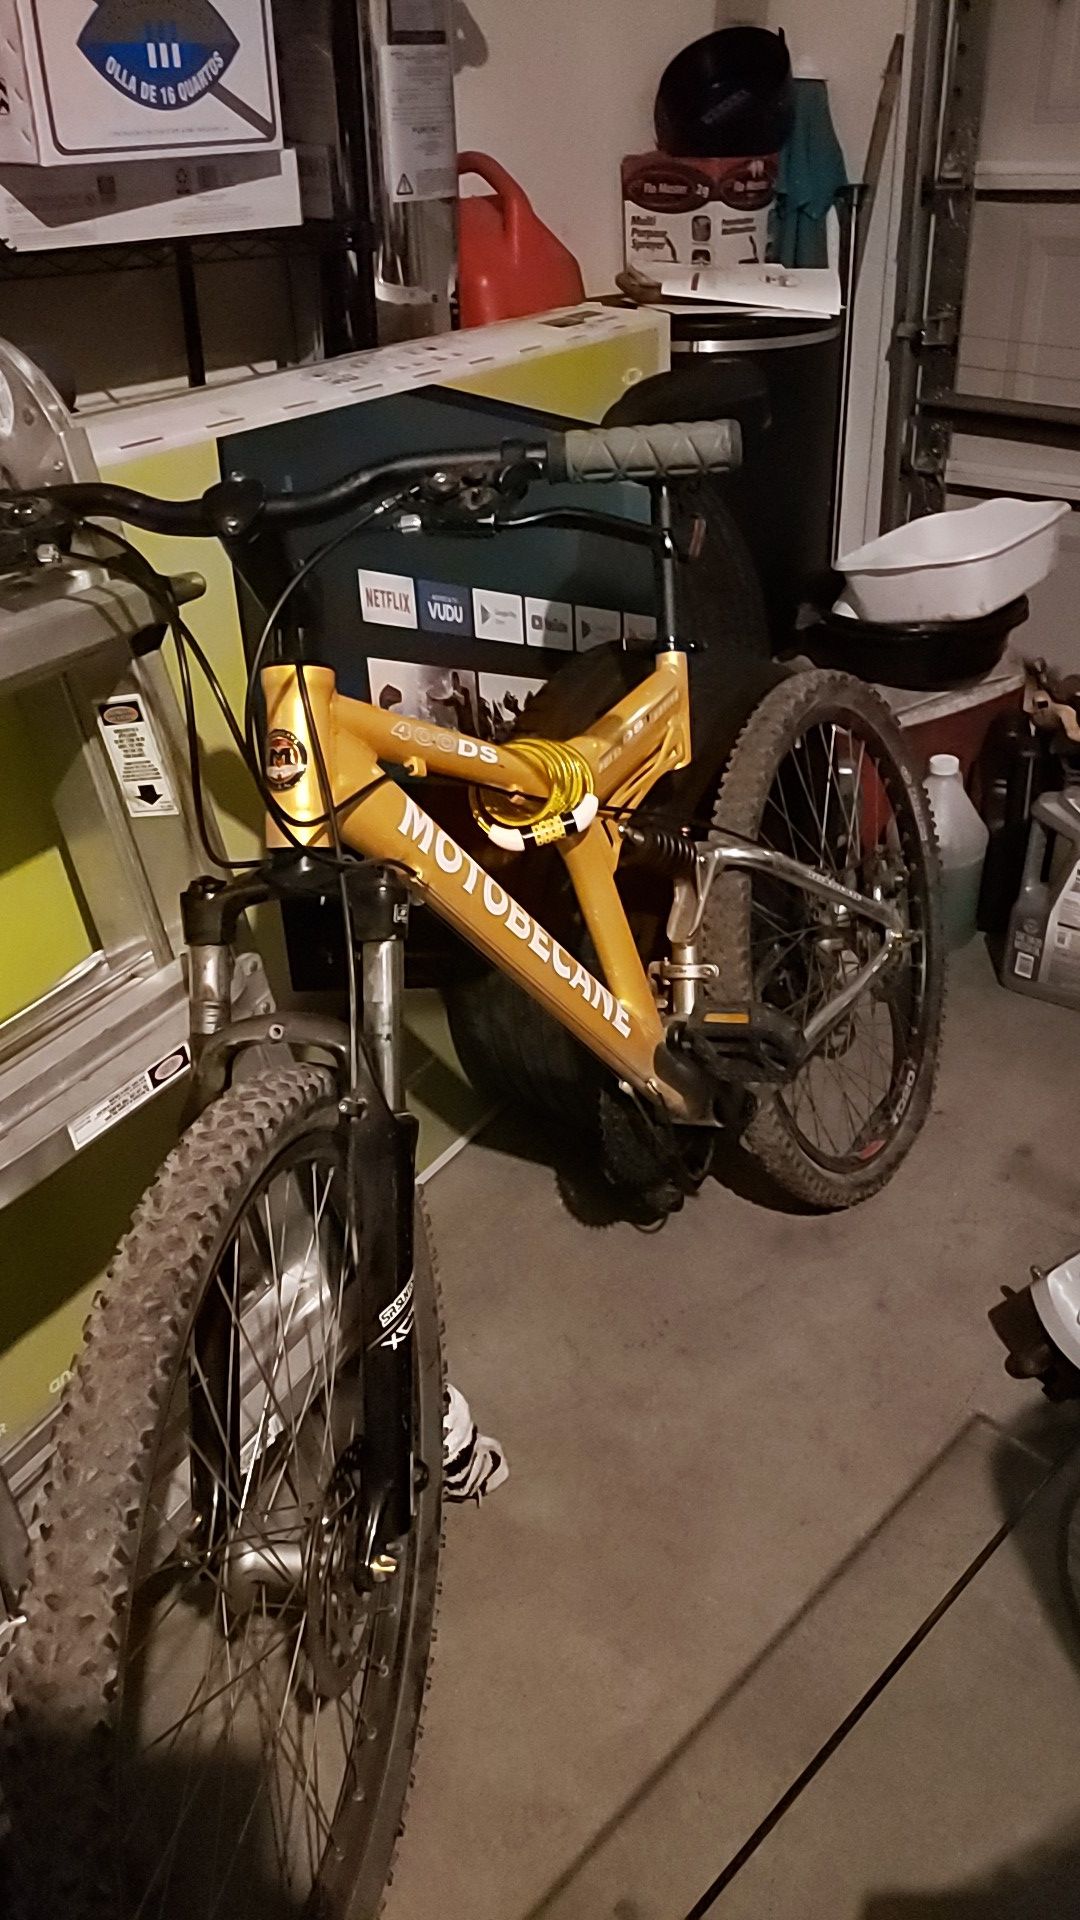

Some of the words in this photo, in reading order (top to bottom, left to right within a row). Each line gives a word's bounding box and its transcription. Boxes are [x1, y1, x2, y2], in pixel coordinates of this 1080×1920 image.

[105, 55, 137, 95] OLLA
[140, 81, 158, 104] DE
[160, 86, 177, 105] 16
[177, 50, 224, 102] QUARTOS
[365, 586, 412, 615] NETFLIX
[427, 600, 464, 624] VUDU
[390, 720, 499, 764] 400DS
[397, 795, 632, 1040] MOTOBECANE
